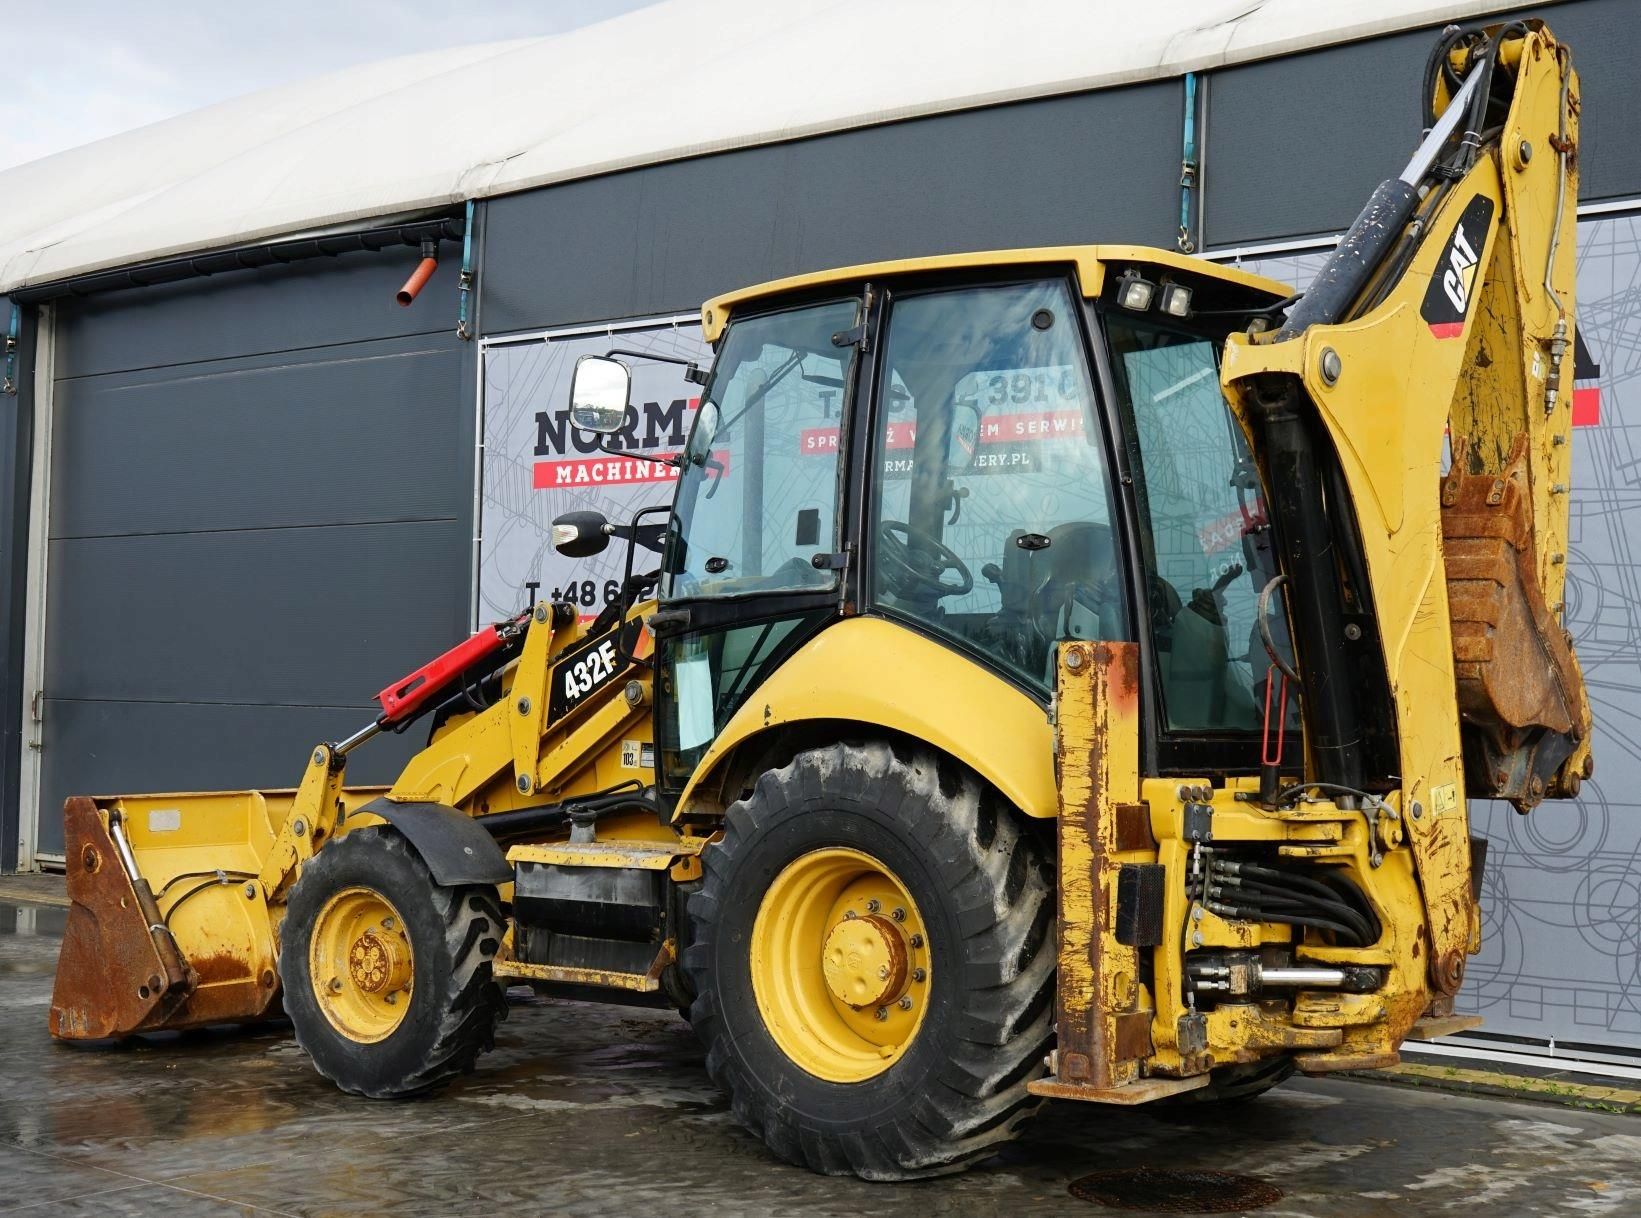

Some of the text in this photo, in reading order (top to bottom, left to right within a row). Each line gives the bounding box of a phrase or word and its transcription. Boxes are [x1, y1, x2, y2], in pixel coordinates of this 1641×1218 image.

[1443, 223, 1478, 314] CAT
[988, 373, 1048, 405] 391
[534, 398, 700, 456] NORM
[1016, 418, 1084, 435] SERWI
[565, 640, 617, 700] 432F
[623, 752, 634, 766] 103
